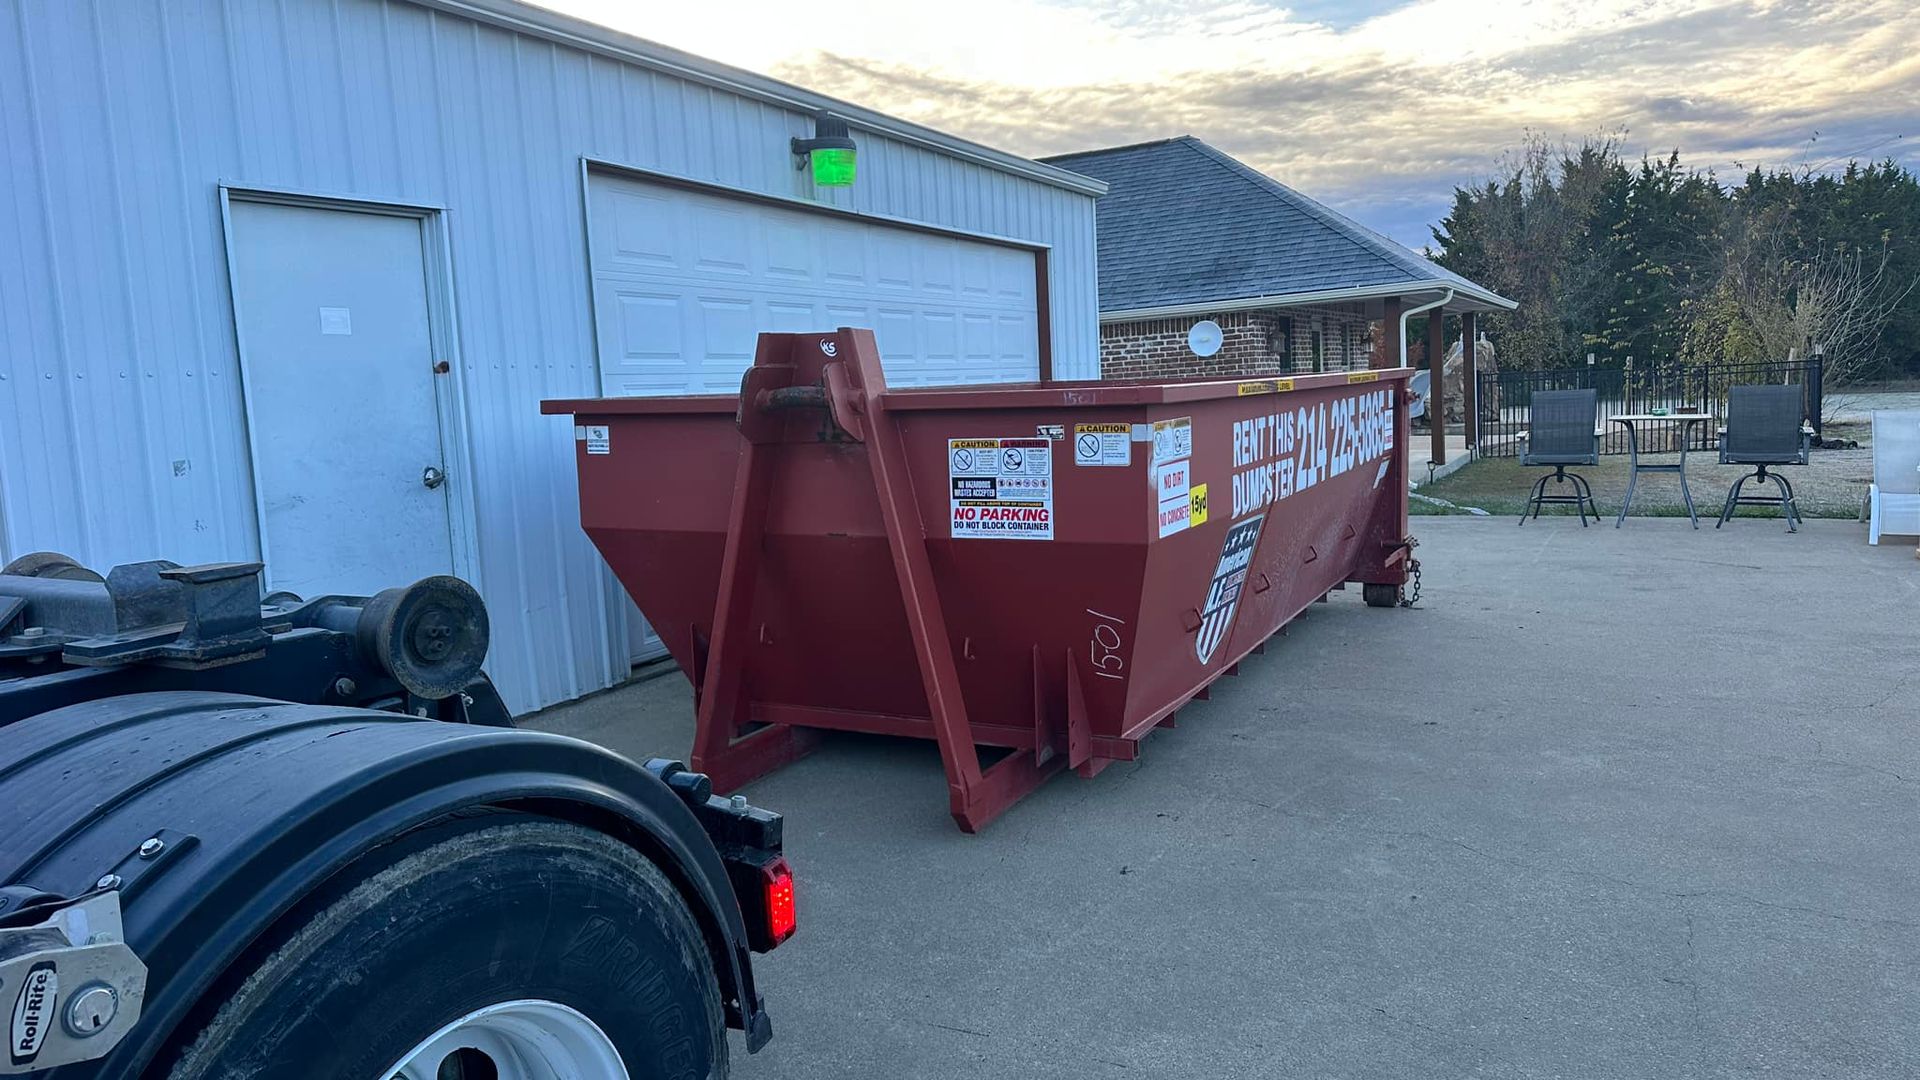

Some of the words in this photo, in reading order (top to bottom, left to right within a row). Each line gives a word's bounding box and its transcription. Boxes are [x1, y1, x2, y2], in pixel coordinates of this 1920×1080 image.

[1086, 425, 1126, 433] CAUTION
[960, 440, 995, 448] CAUTION
[1009, 440, 1047, 448] WARNING
[1233, 416, 1266, 468] RENT
[1268, 411, 1294, 457] THIS
[1296, 402, 1327, 493] 214
[1330, 390, 1385, 478] 225-5865
[958, 481, 964, 489] NO
[965, 481, 991, 489] HAZARDOUS
[1163, 473, 1171, 490] NO
[1172, 470, 1184, 487] DIRT
[972, 489, 995, 497] ACCEPTED
[1231, 457, 1295, 520] DUMPSTER
[1191, 492, 1207, 515] 15yd
[954, 507, 976, 521] NO
[980, 508, 1050, 522] PARKING
[1159, 511, 1167, 527] NO
[1167, 505, 1190, 525] CONCRETE
[953, 521, 964, 529] DO
[966, 521, 979, 530] NOT
[982, 521, 1006, 530] BLOCK
[1007, 522, 1049, 531] CONTAINER
